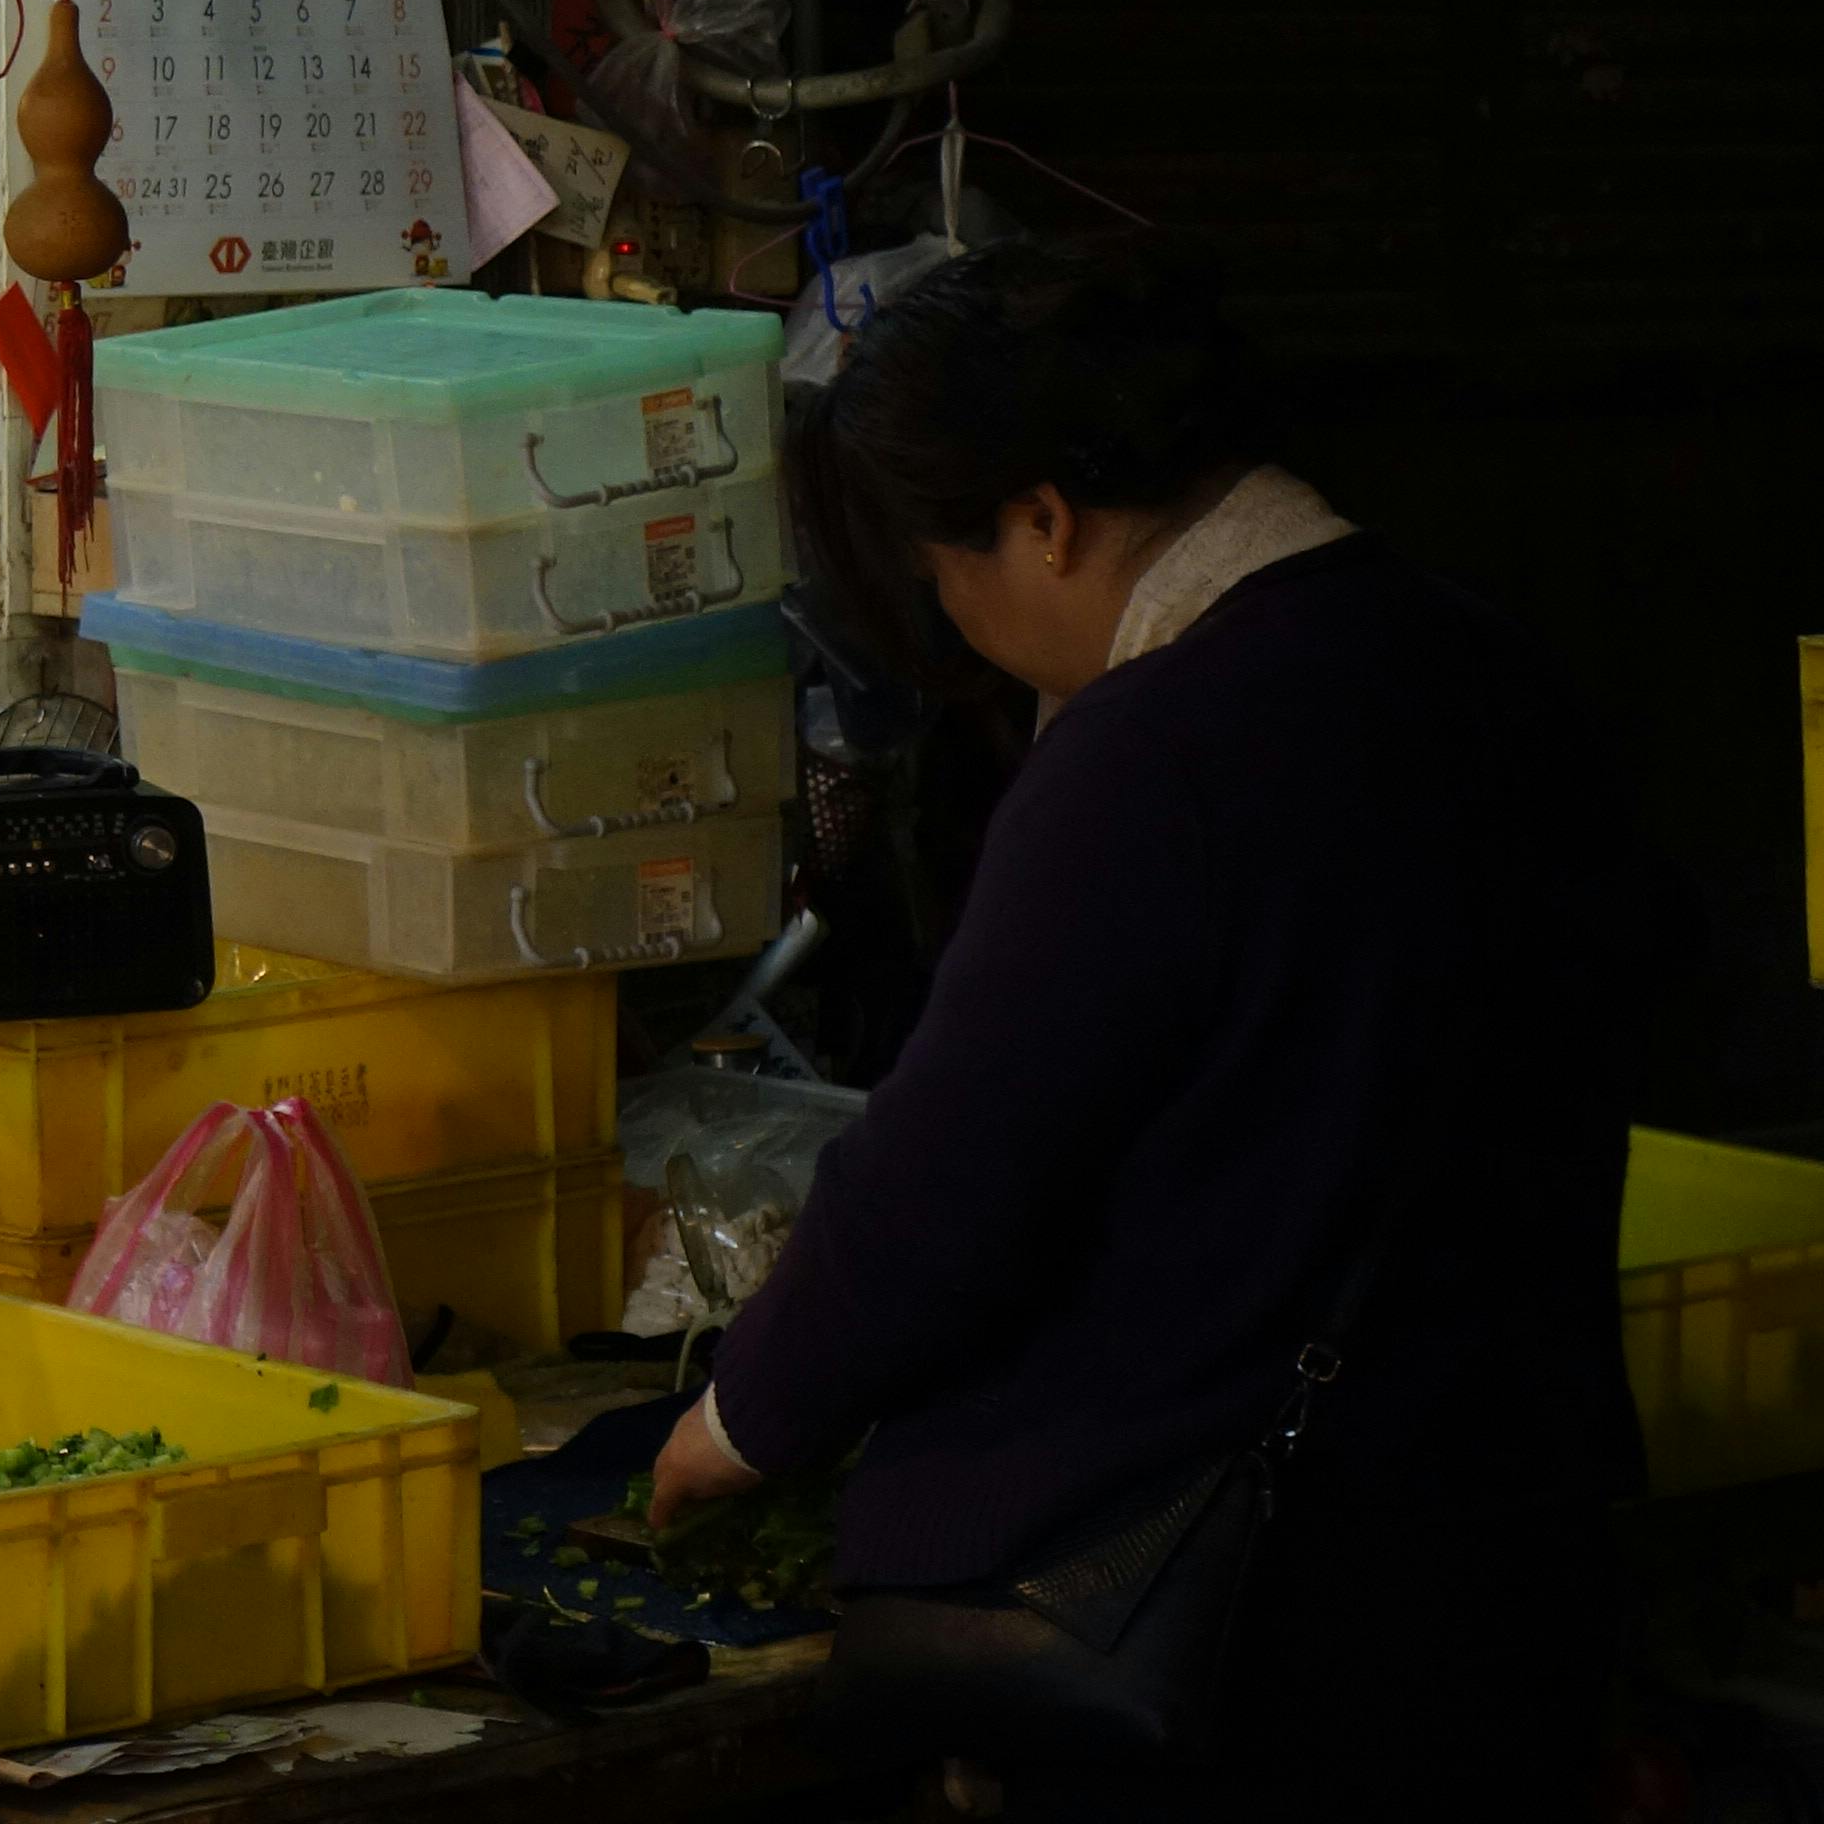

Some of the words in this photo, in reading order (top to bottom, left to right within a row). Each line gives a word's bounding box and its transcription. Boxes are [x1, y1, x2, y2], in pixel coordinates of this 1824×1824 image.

[102, 57, 116, 82] 9
[152, 57, 175, 82] 10
[204, 56, 224, 81] 11
[252, 56, 275, 81] 12
[301, 55, 324, 79] 13
[350, 56, 372, 79] 14
[398, 55, 422, 80] 15
[110, 118, 123, 142] 6
[154, 115, 178, 141] 17
[208, 114, 230, 141] 18
[259, 113, 282, 139] 19
[306, 112, 331, 138] 20
[354, 112, 377, 138] 21
[403, 111, 426, 136] 22
[142, 178, 161, 199] 24
[168, 177, 188, 199] 31
[206, 174, 232, 200] 25
[258, 172, 285, 199] 26
[311, 171, 335, 197] 27
[361, 170, 386, 196] 28
[409, 169, 433, 194] 29
